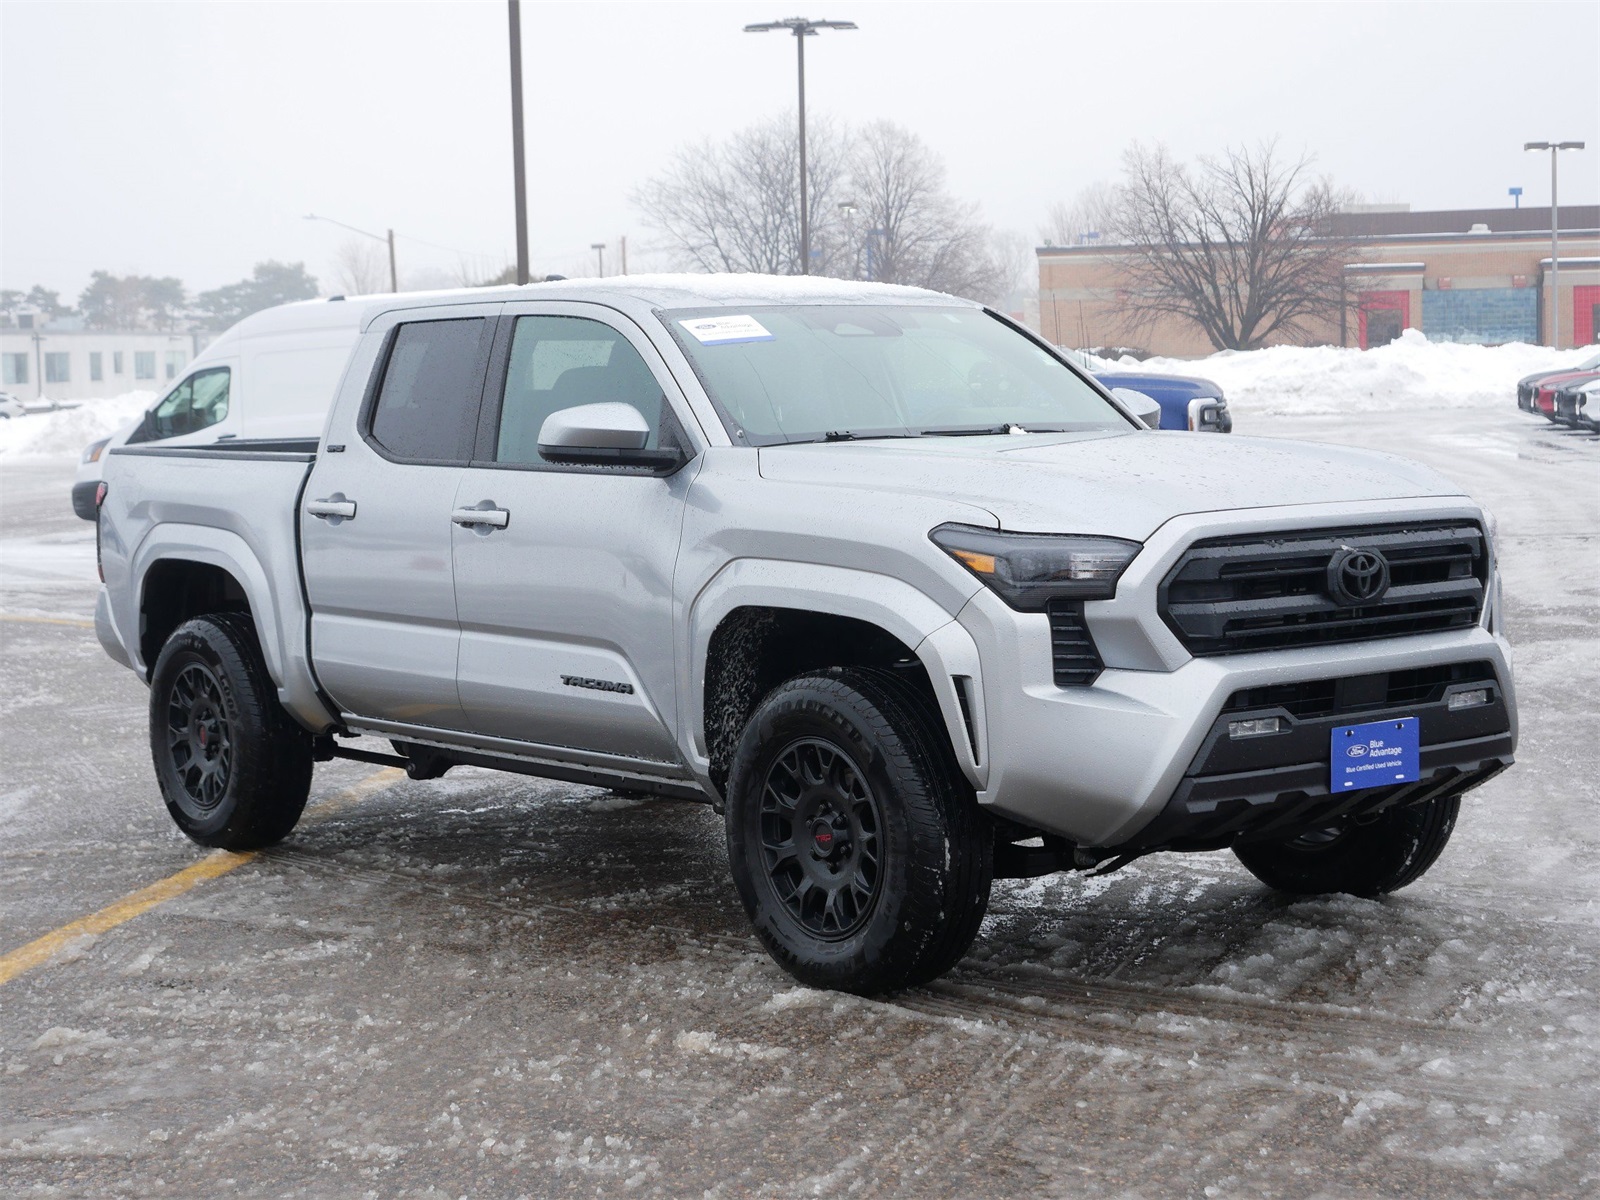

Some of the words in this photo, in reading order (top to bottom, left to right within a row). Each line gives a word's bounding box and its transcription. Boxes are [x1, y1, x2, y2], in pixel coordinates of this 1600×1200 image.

[560, 674, 634, 695] TACOMA
[1369, 740, 1384, 749] Blue
[1349, 745, 1366, 756] Ford
[1369, 746, 1402, 758] Advantage
[1356, 763, 1375, 771] Certified
[1375, 761, 1386, 769] Used
[1386, 760, 1402, 768] Vehicle
[815, 833, 832, 842] TRD
